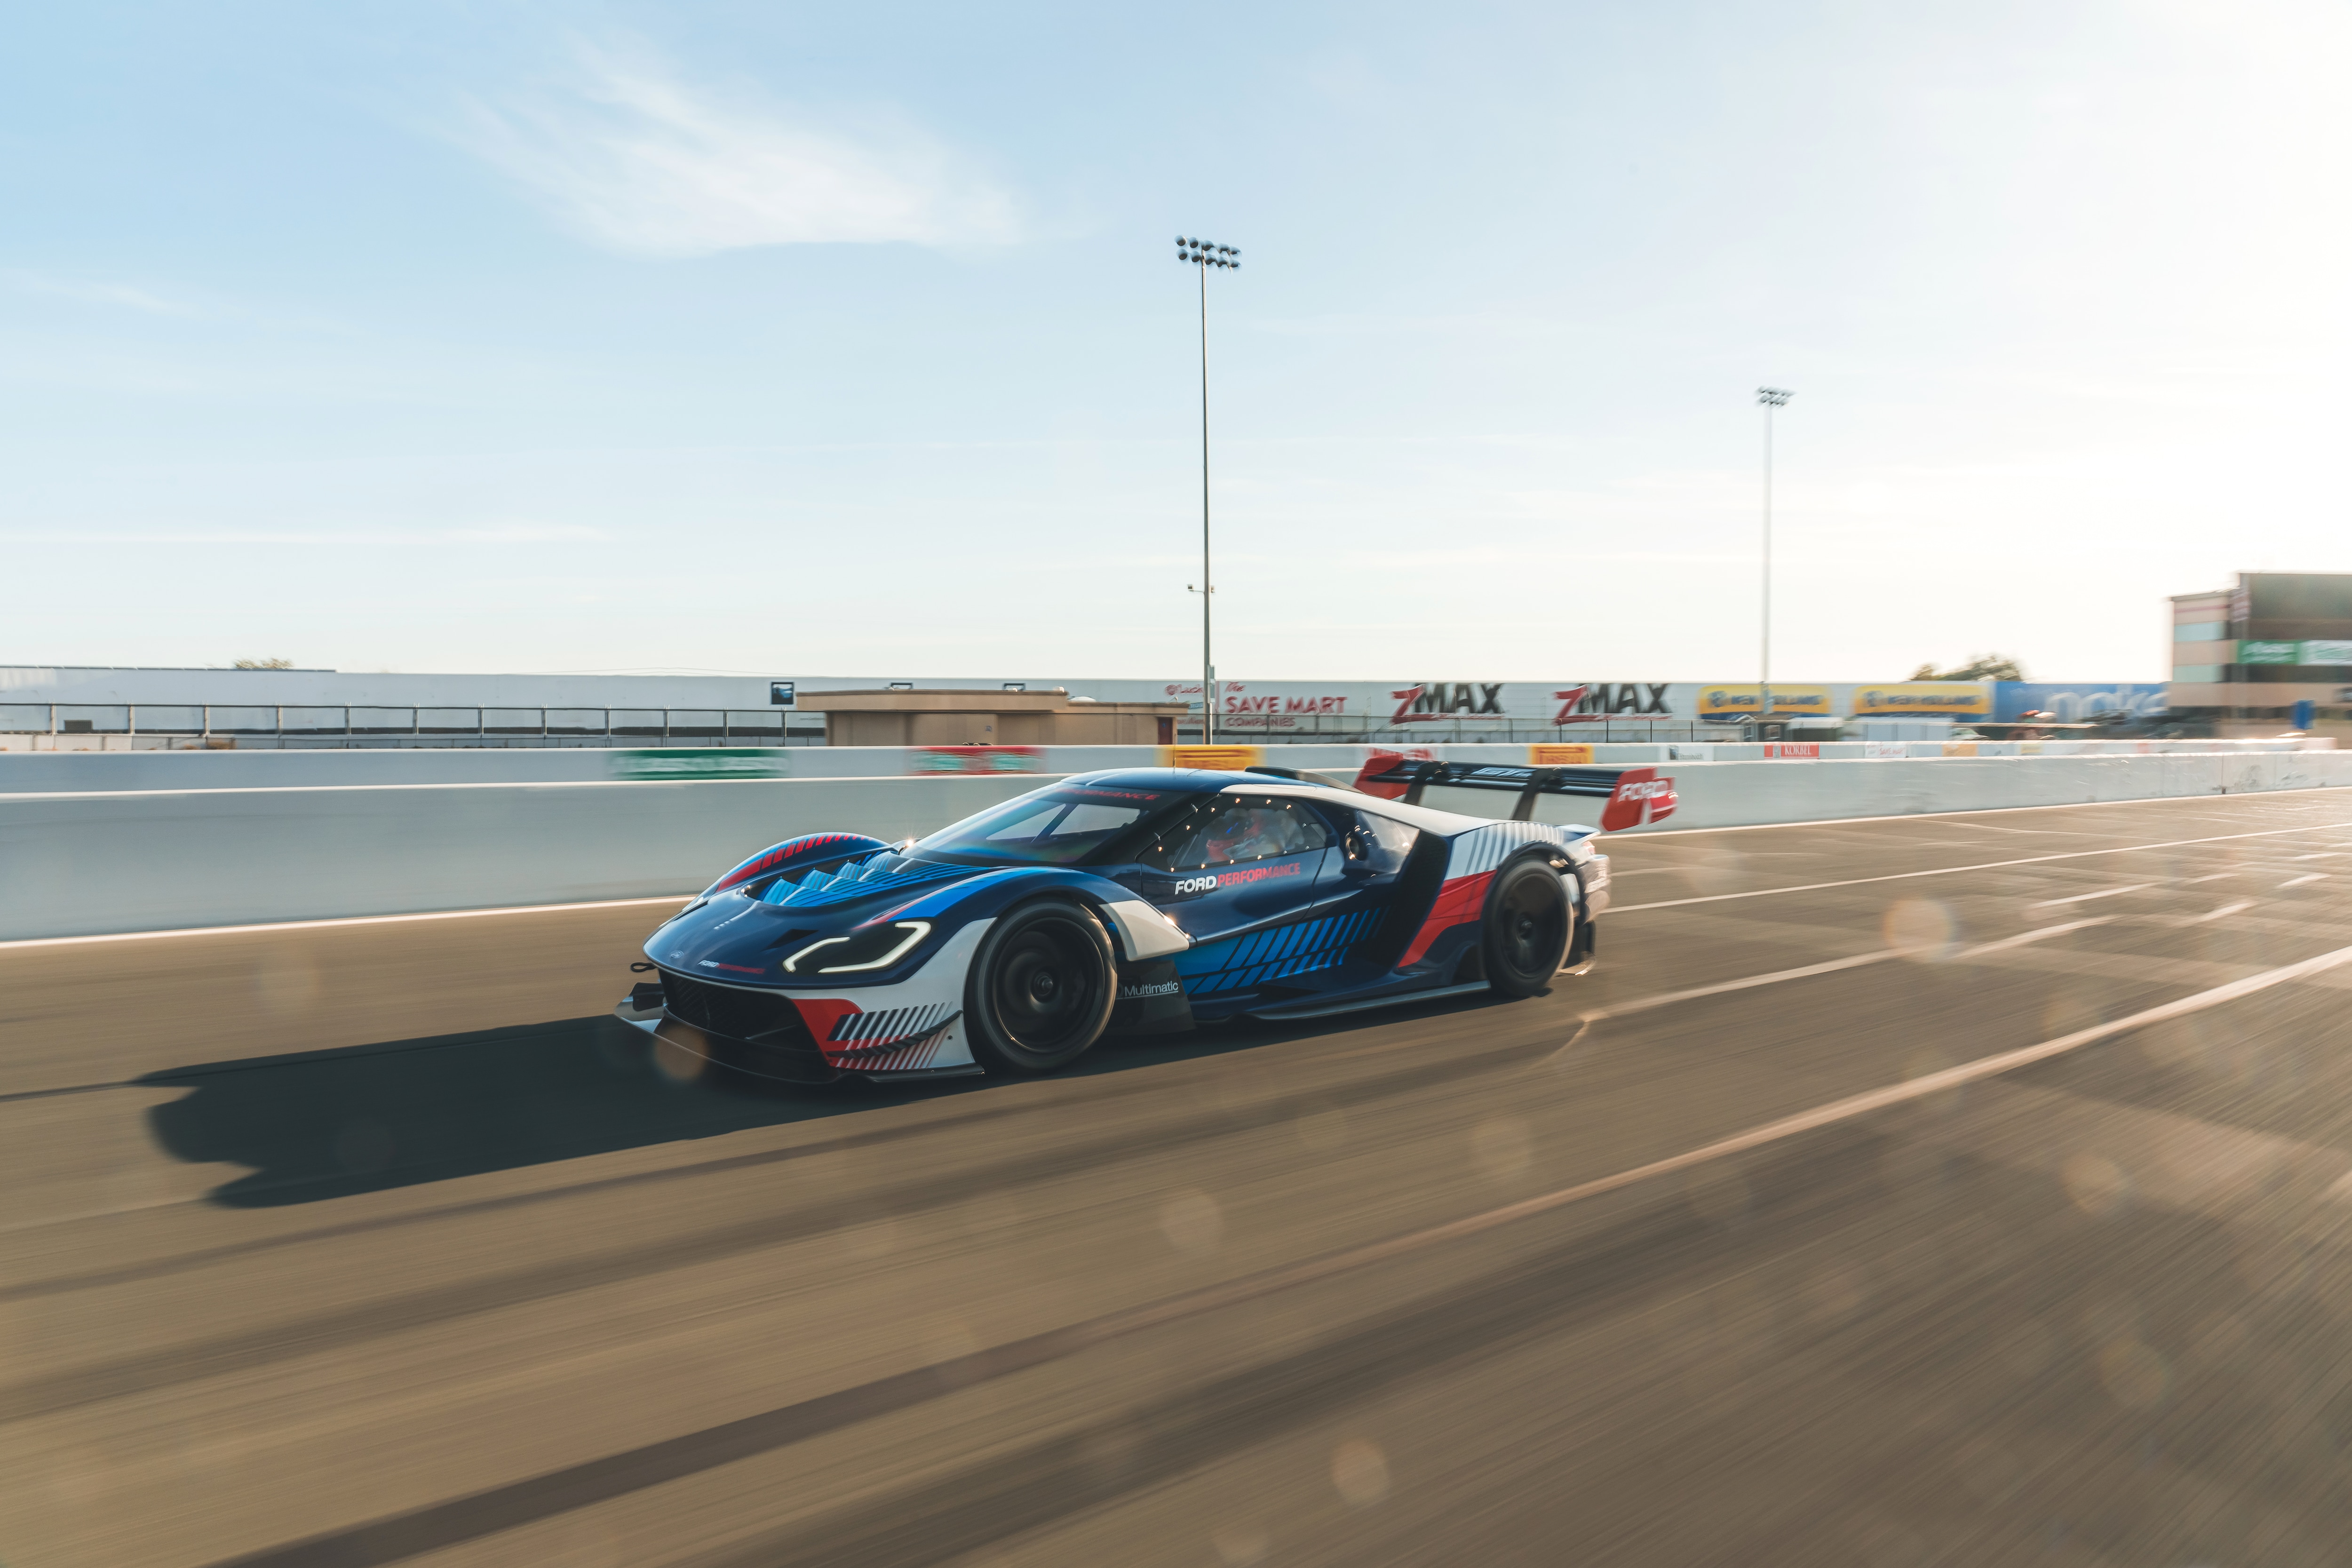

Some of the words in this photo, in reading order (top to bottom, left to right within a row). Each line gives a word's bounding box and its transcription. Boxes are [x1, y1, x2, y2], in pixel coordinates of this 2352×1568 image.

[1225, 696, 1280, 713] SAVE
[1285, 696, 1348, 713] MART
[1224, 717, 1295, 727] COMPANIES
[1785, 746, 1812, 756] KORBEL
[1617, 780, 1669, 803] FORD
[1175, 876, 1217, 895] FORD
[1217, 862, 1300, 887] PERFORMANCE
[1125, 981, 1179, 997] Multimatic
